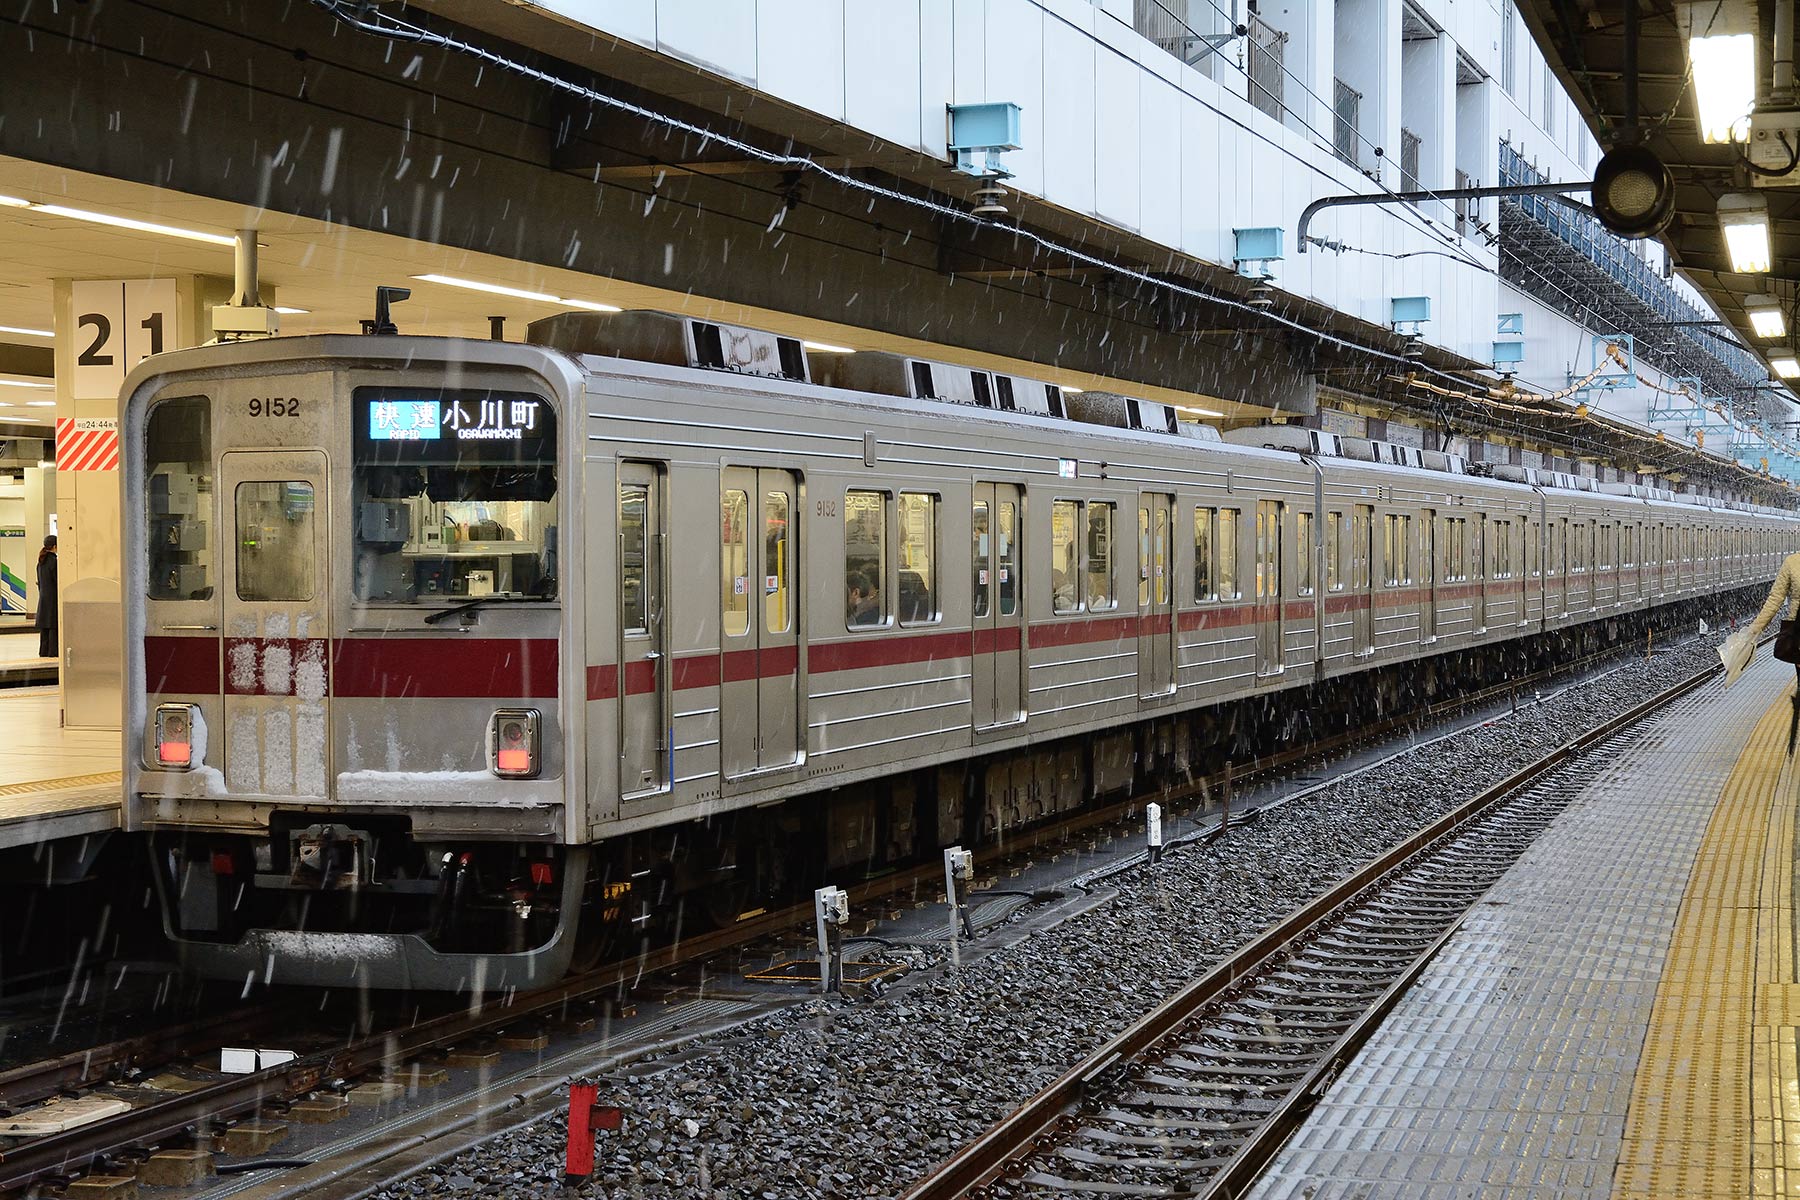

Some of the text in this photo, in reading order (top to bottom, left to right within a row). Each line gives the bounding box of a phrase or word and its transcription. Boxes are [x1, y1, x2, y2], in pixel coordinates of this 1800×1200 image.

[78, 312, 163, 366] 2 1
[248, 397, 300, 417] 9152
[374, 399, 540, 430] 快速 小川町
[389, 429, 420, 439] RAPID
[816, 500, 836, 517] 9152
